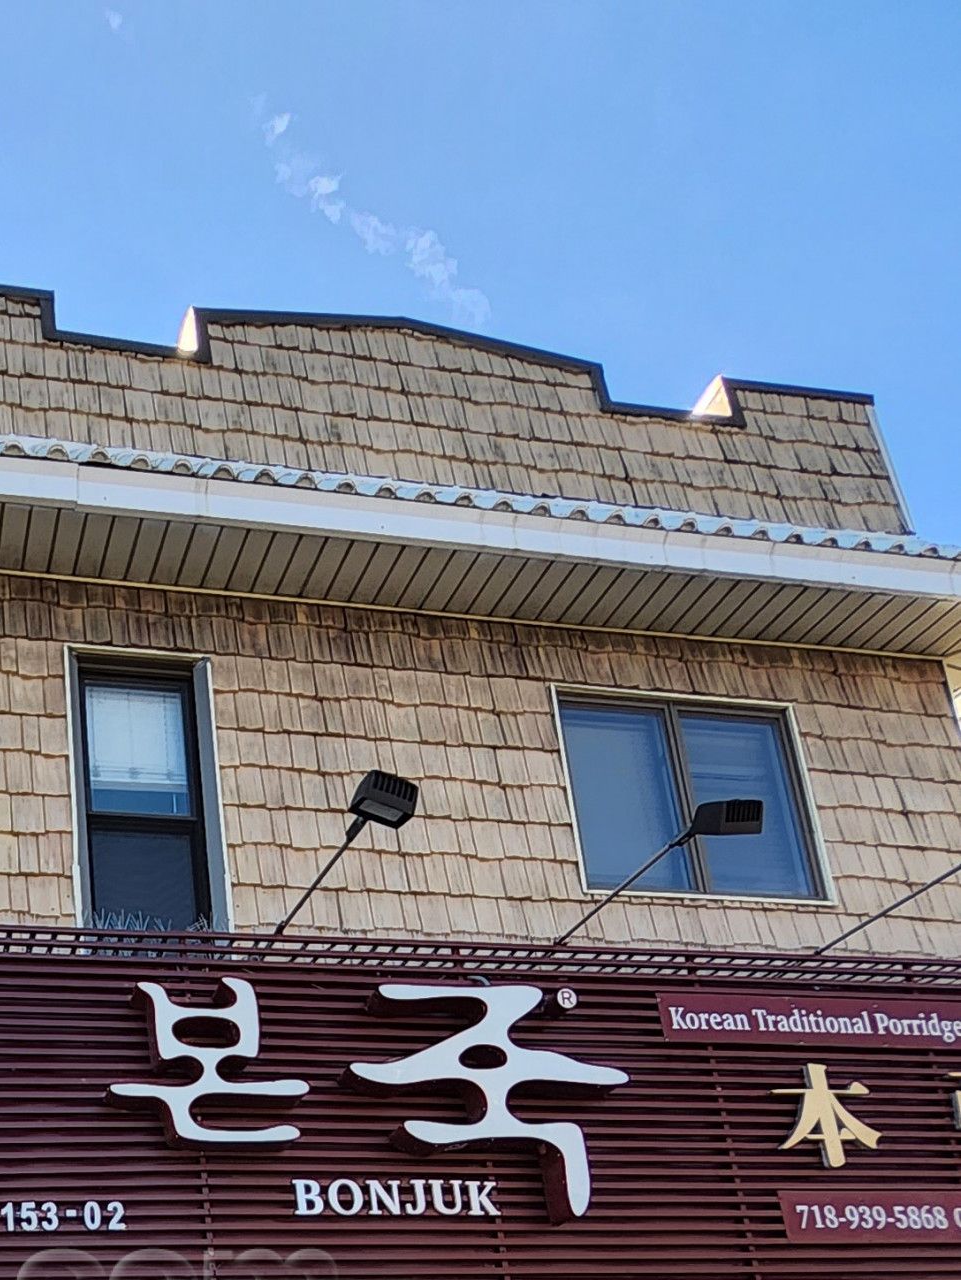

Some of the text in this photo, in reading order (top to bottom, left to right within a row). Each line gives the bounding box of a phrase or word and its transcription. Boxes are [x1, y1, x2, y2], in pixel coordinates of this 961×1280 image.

[668, 1006, 961, 1043] Korean Traditional Porridge
[291, 1178, 501, 1217] BONJUK
[0, 1201, 128, 1232] 153-02
[795, 1204, 949, 1230] 718-939-5868
